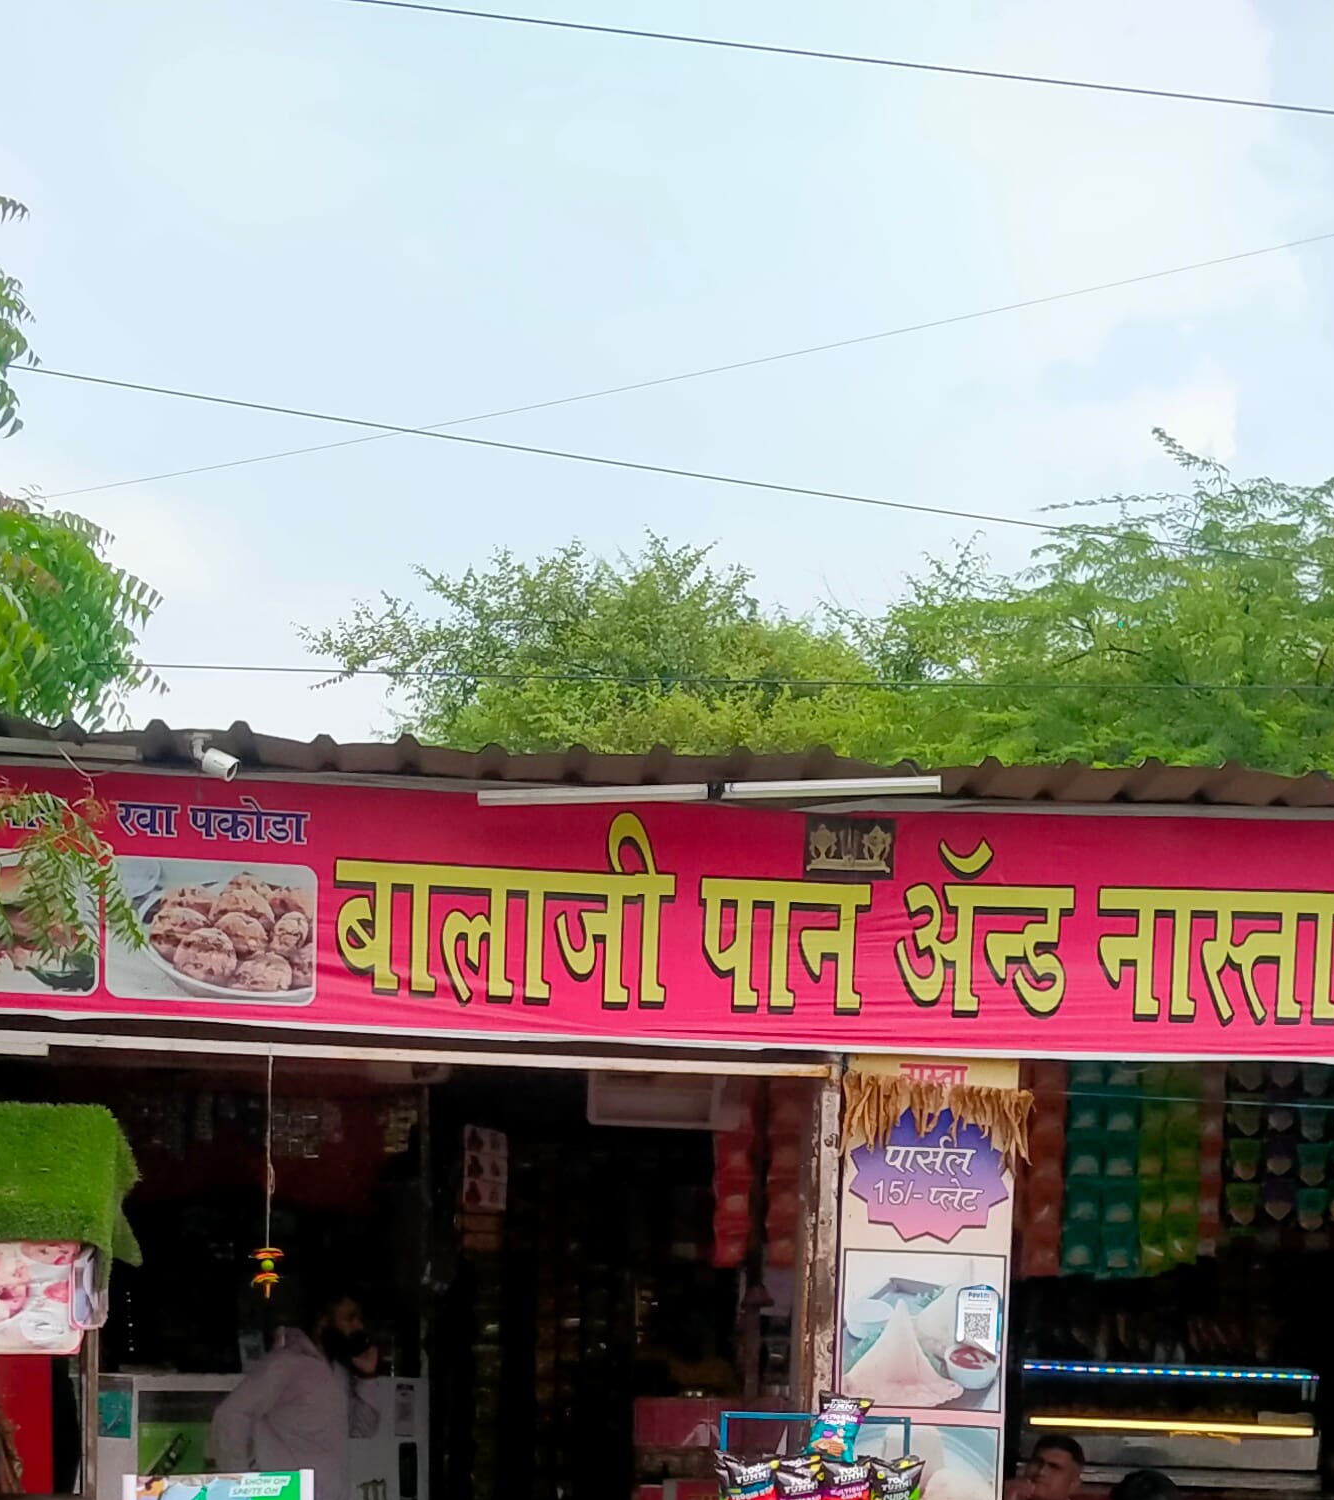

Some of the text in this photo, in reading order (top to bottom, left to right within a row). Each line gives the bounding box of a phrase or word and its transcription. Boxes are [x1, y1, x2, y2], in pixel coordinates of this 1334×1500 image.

[117, 797, 310, 845] रवा पकोडा
[334, 810, 676, 1011] बालाजी
[700, 874, 873, 1016] पान
[885, 1135, 978, 1177] पार्सल
[873, 1177, 984, 1212] 15/- प्लेट
